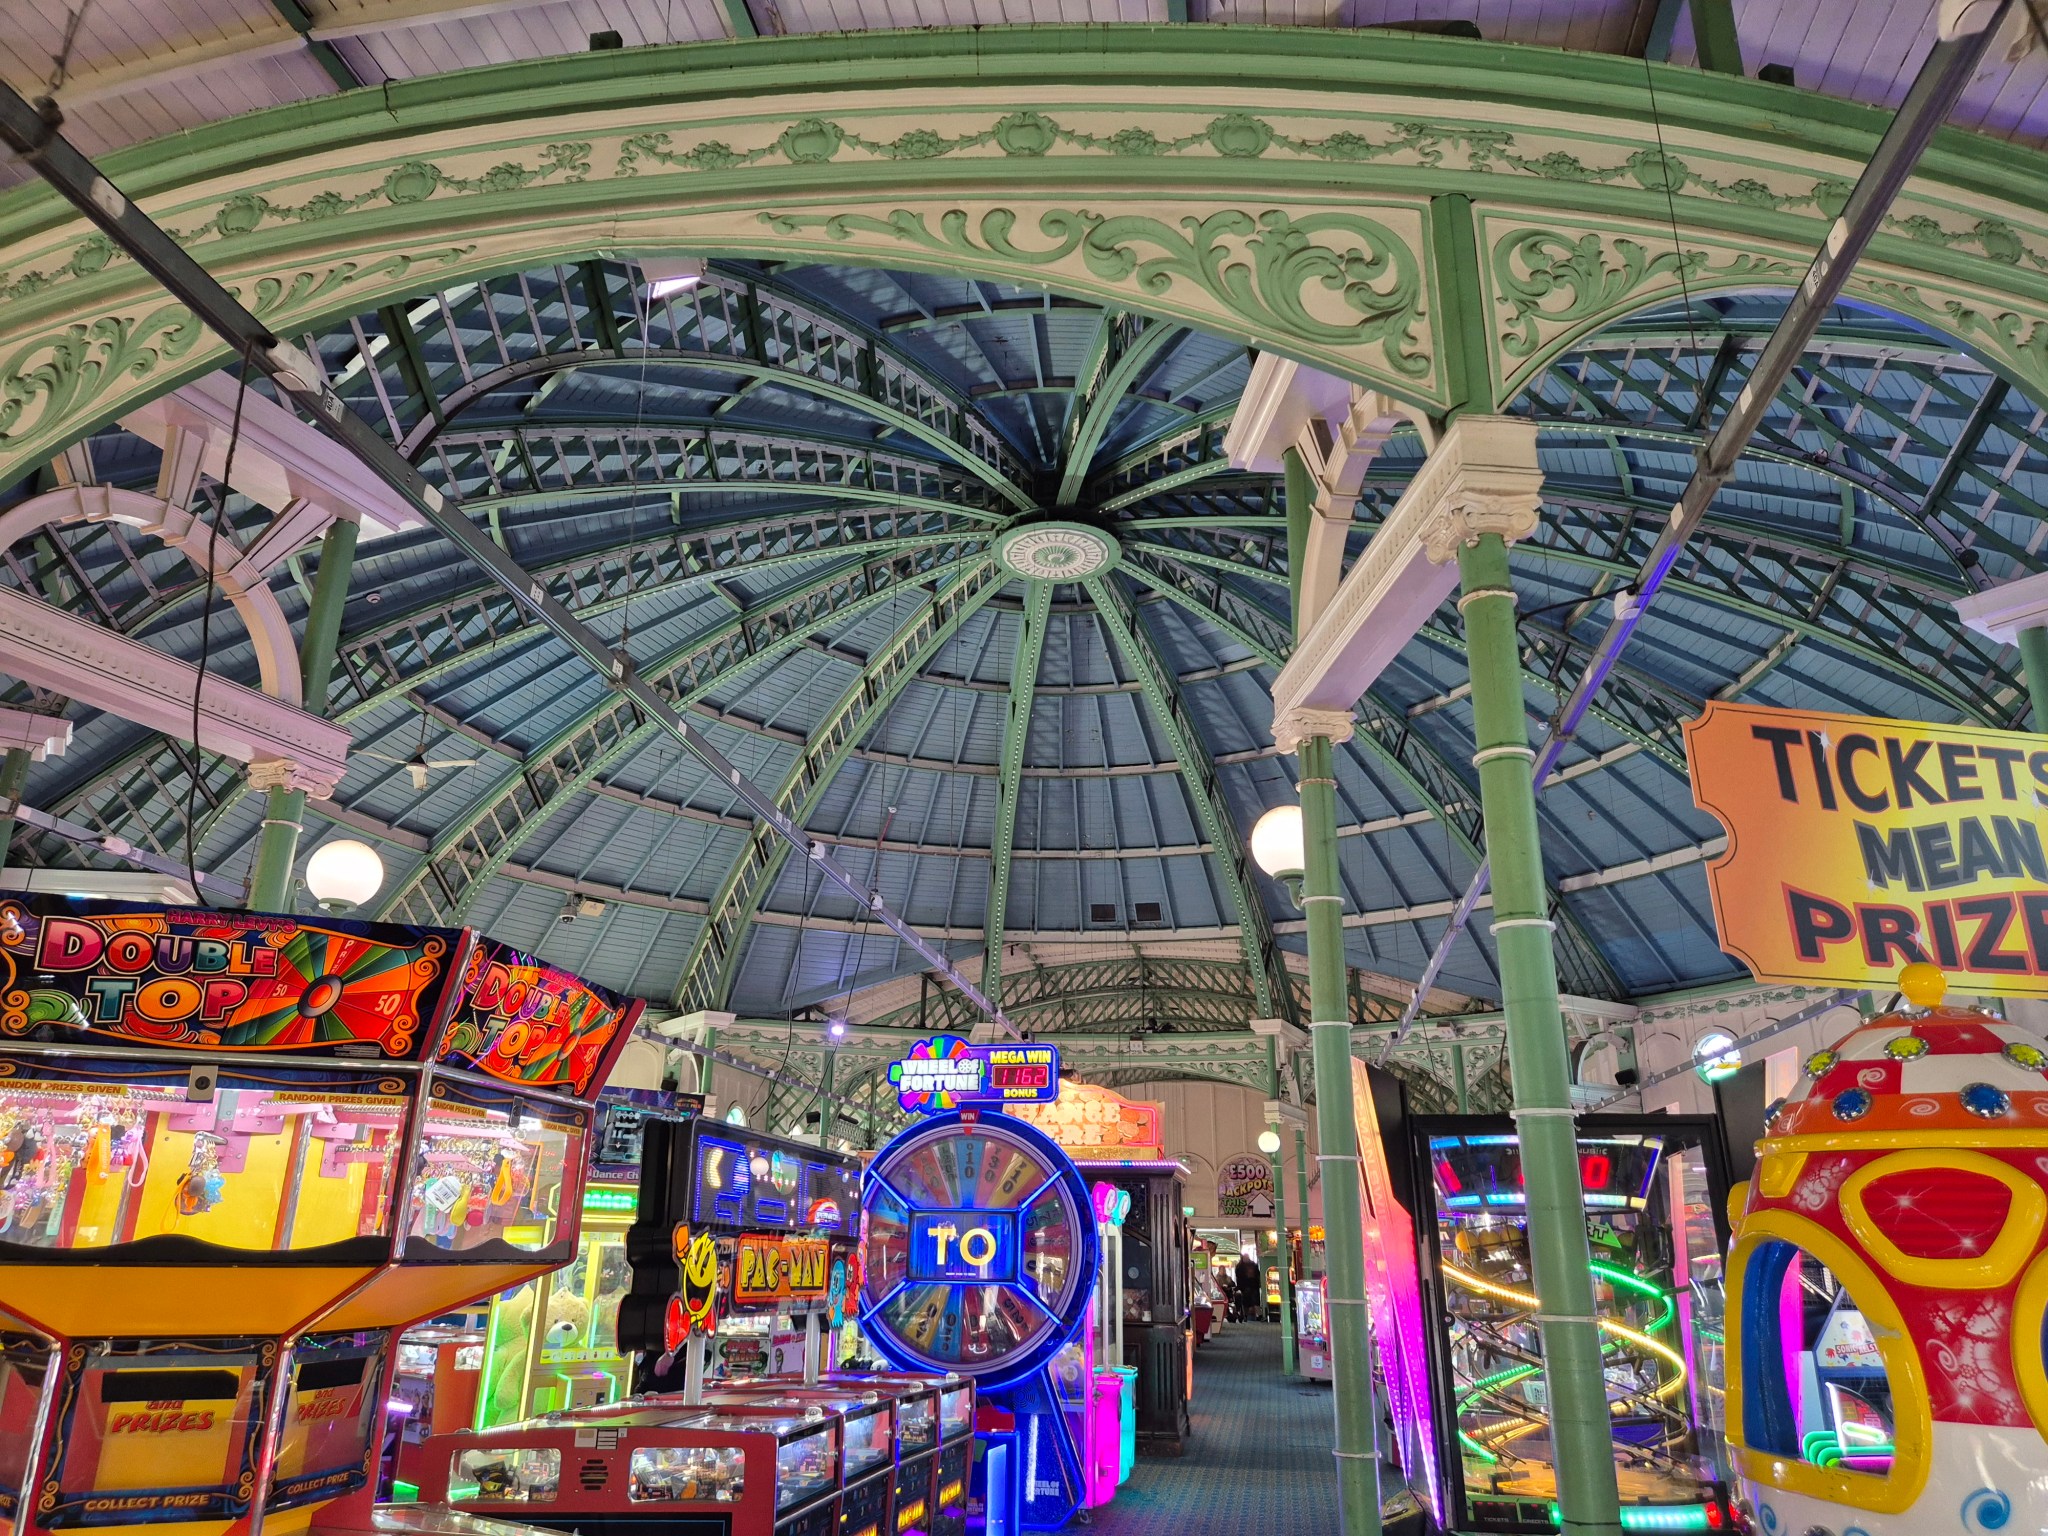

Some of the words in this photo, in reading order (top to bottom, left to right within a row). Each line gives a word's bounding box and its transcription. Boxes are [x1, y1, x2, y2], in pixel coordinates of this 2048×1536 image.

[1852, 814, 2048, 892] MEAN
[166, 909, 231, 928] HARRY
[234, 913, 296, 932] LEVY'S
[34, 916, 279, 977] DOUBLE
[85, 975, 248, 1023] TOP
[273, 984, 287, 997] 50
[470, 961, 570, 1026] DOUBLE
[375, 994, 401, 1015] 50
[477, 1014, 549, 1059] TOP
[990, 1051, 1026, 1064] MEGA
[1028, 1051, 1051, 1063] WIN
[901, 1060, 957, 1074] WHEEL
[958, 1059, 979, 1074] OF
[900, 1075, 979, 1092] FORTUNE
[1001, 1068, 1047, 1085] 1162
[44, 1083, 84, 1092] PRIZES
[87, 1085, 121, 1094] GIVEN
[1004, 1088, 1037, 1098] BONUS
[279, 1093, 326, 1102] RANDOM
[329, 1095, 363, 1104] PRIZES
[366, 1097, 397, 1105] GIVEN
[432, 1101, 454, 1111] RANDOM
[455, 1105, 471, 1114] PRIZES
[471, 1108, 485, 1118] GIVEN
[961, 1112, 975, 1121] WIN
[1034, 1124, 1102, 1145] ERE
[592, 1169, 624, 1179] Dance
[1229, 1164, 1266, 1179] £500
[1223, 1198, 1248, 1207] THIS
[1224, 1207, 1246, 1215] WAY
[928, 1226, 996, 1266] TO
[741, 1245, 825, 1292] PAC-MAN
[146, 1400, 183, 1410] and
[297, 1398, 345, 1421] PRIZES
[112, 1409, 214, 1433] PRIZES
[287, 1479, 326, 1495] COLLECT
[326, 1472, 350, 1487] PRIZE
[84, 1496, 159, 1512] COLLECT
[163, 1494, 209, 1508] PRIZE
